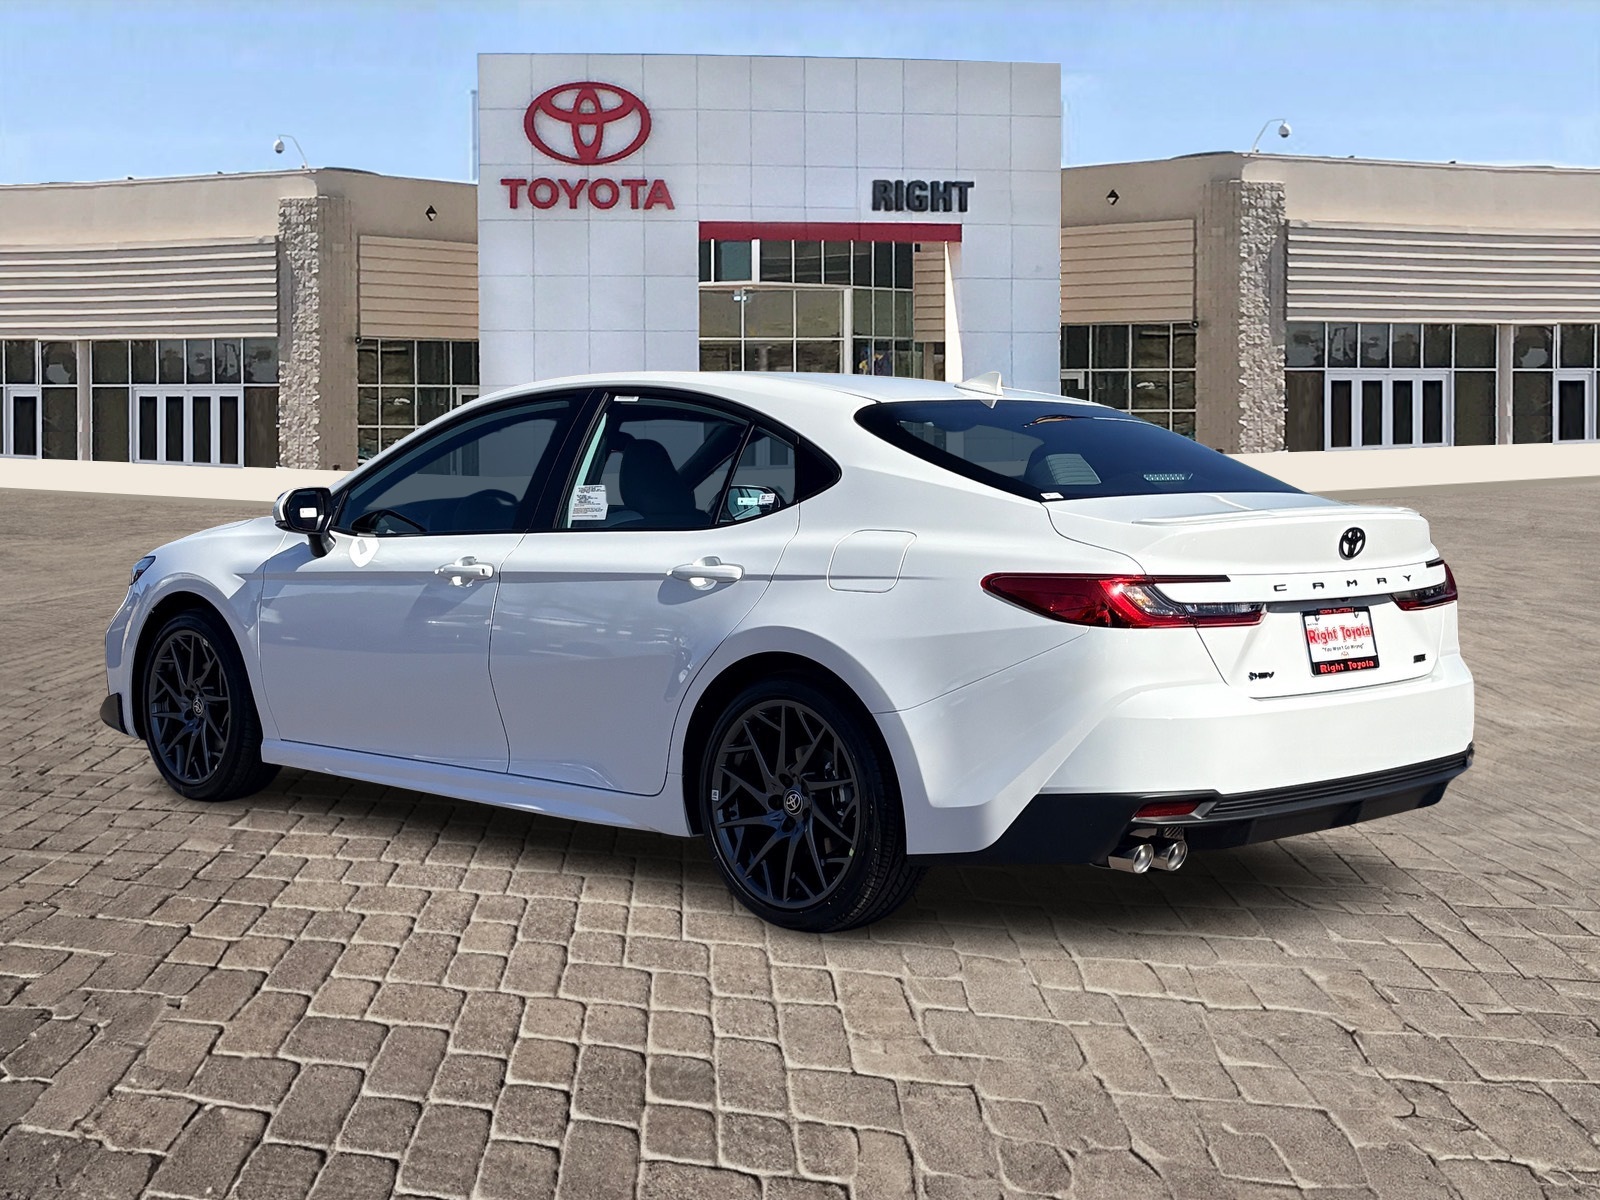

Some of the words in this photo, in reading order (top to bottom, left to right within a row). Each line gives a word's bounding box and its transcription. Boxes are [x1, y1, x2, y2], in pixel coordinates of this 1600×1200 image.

[501, 179, 675, 210] TOYOTA
[872, 180, 975, 212] RIGHT
[1273, 574, 1412, 592] CAMRY
[1307, 626, 1338, 645] Right
[1339, 624, 1371, 642] Toyota
[1320, 664, 1344, 673] Right
[1348, 660, 1374, 670] Toyota
